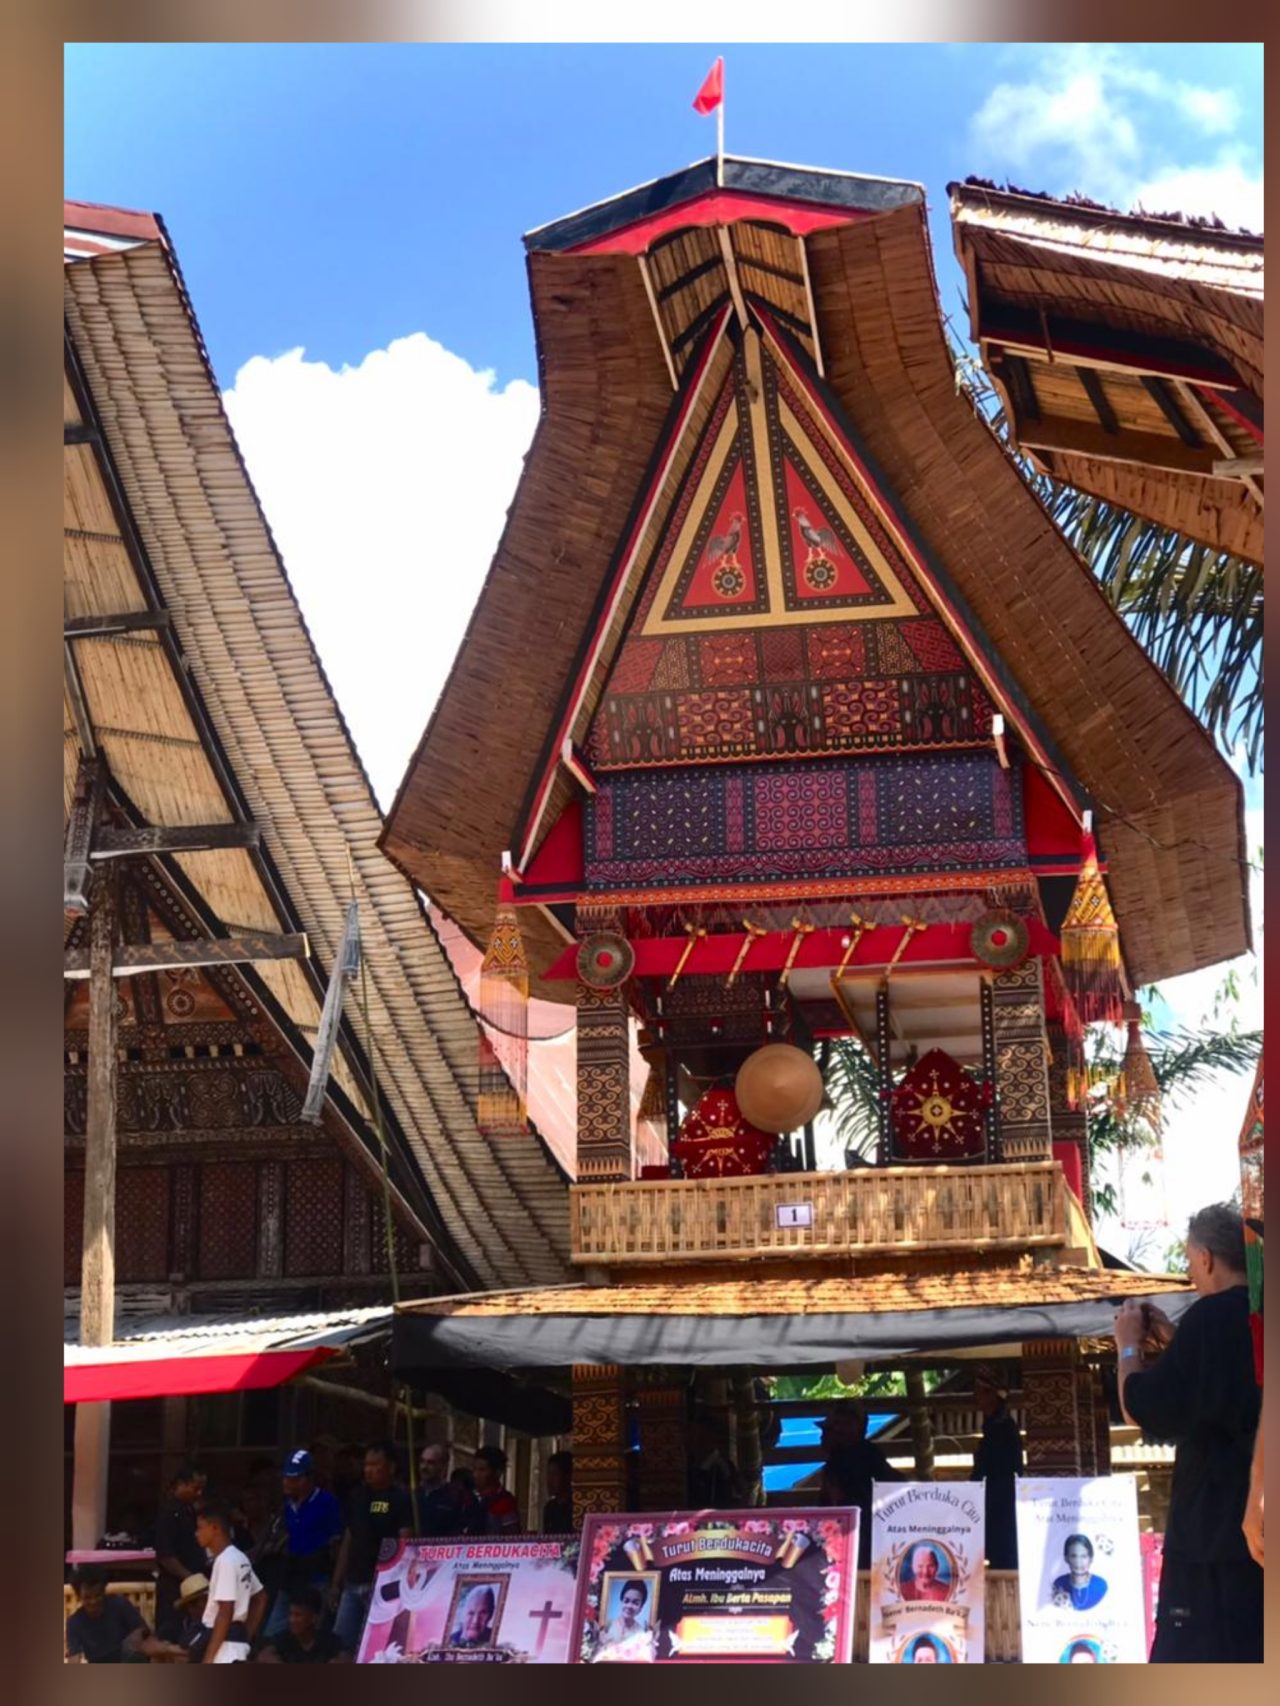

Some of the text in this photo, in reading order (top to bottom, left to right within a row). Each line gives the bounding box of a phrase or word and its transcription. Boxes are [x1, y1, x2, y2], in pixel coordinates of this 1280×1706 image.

[791, 1208, 798, 1222] 1
[907, 1487, 960, 1507] Berduka
[887, 1525, 971, 1535] Atas Meninggalnya
[420, 1543, 561, 1559] TURUT BERDUKACITA
[662, 1537, 773, 1558] Turut Berdukacita
[669, 1566, 766, 1584] Atas Meninggalnya
